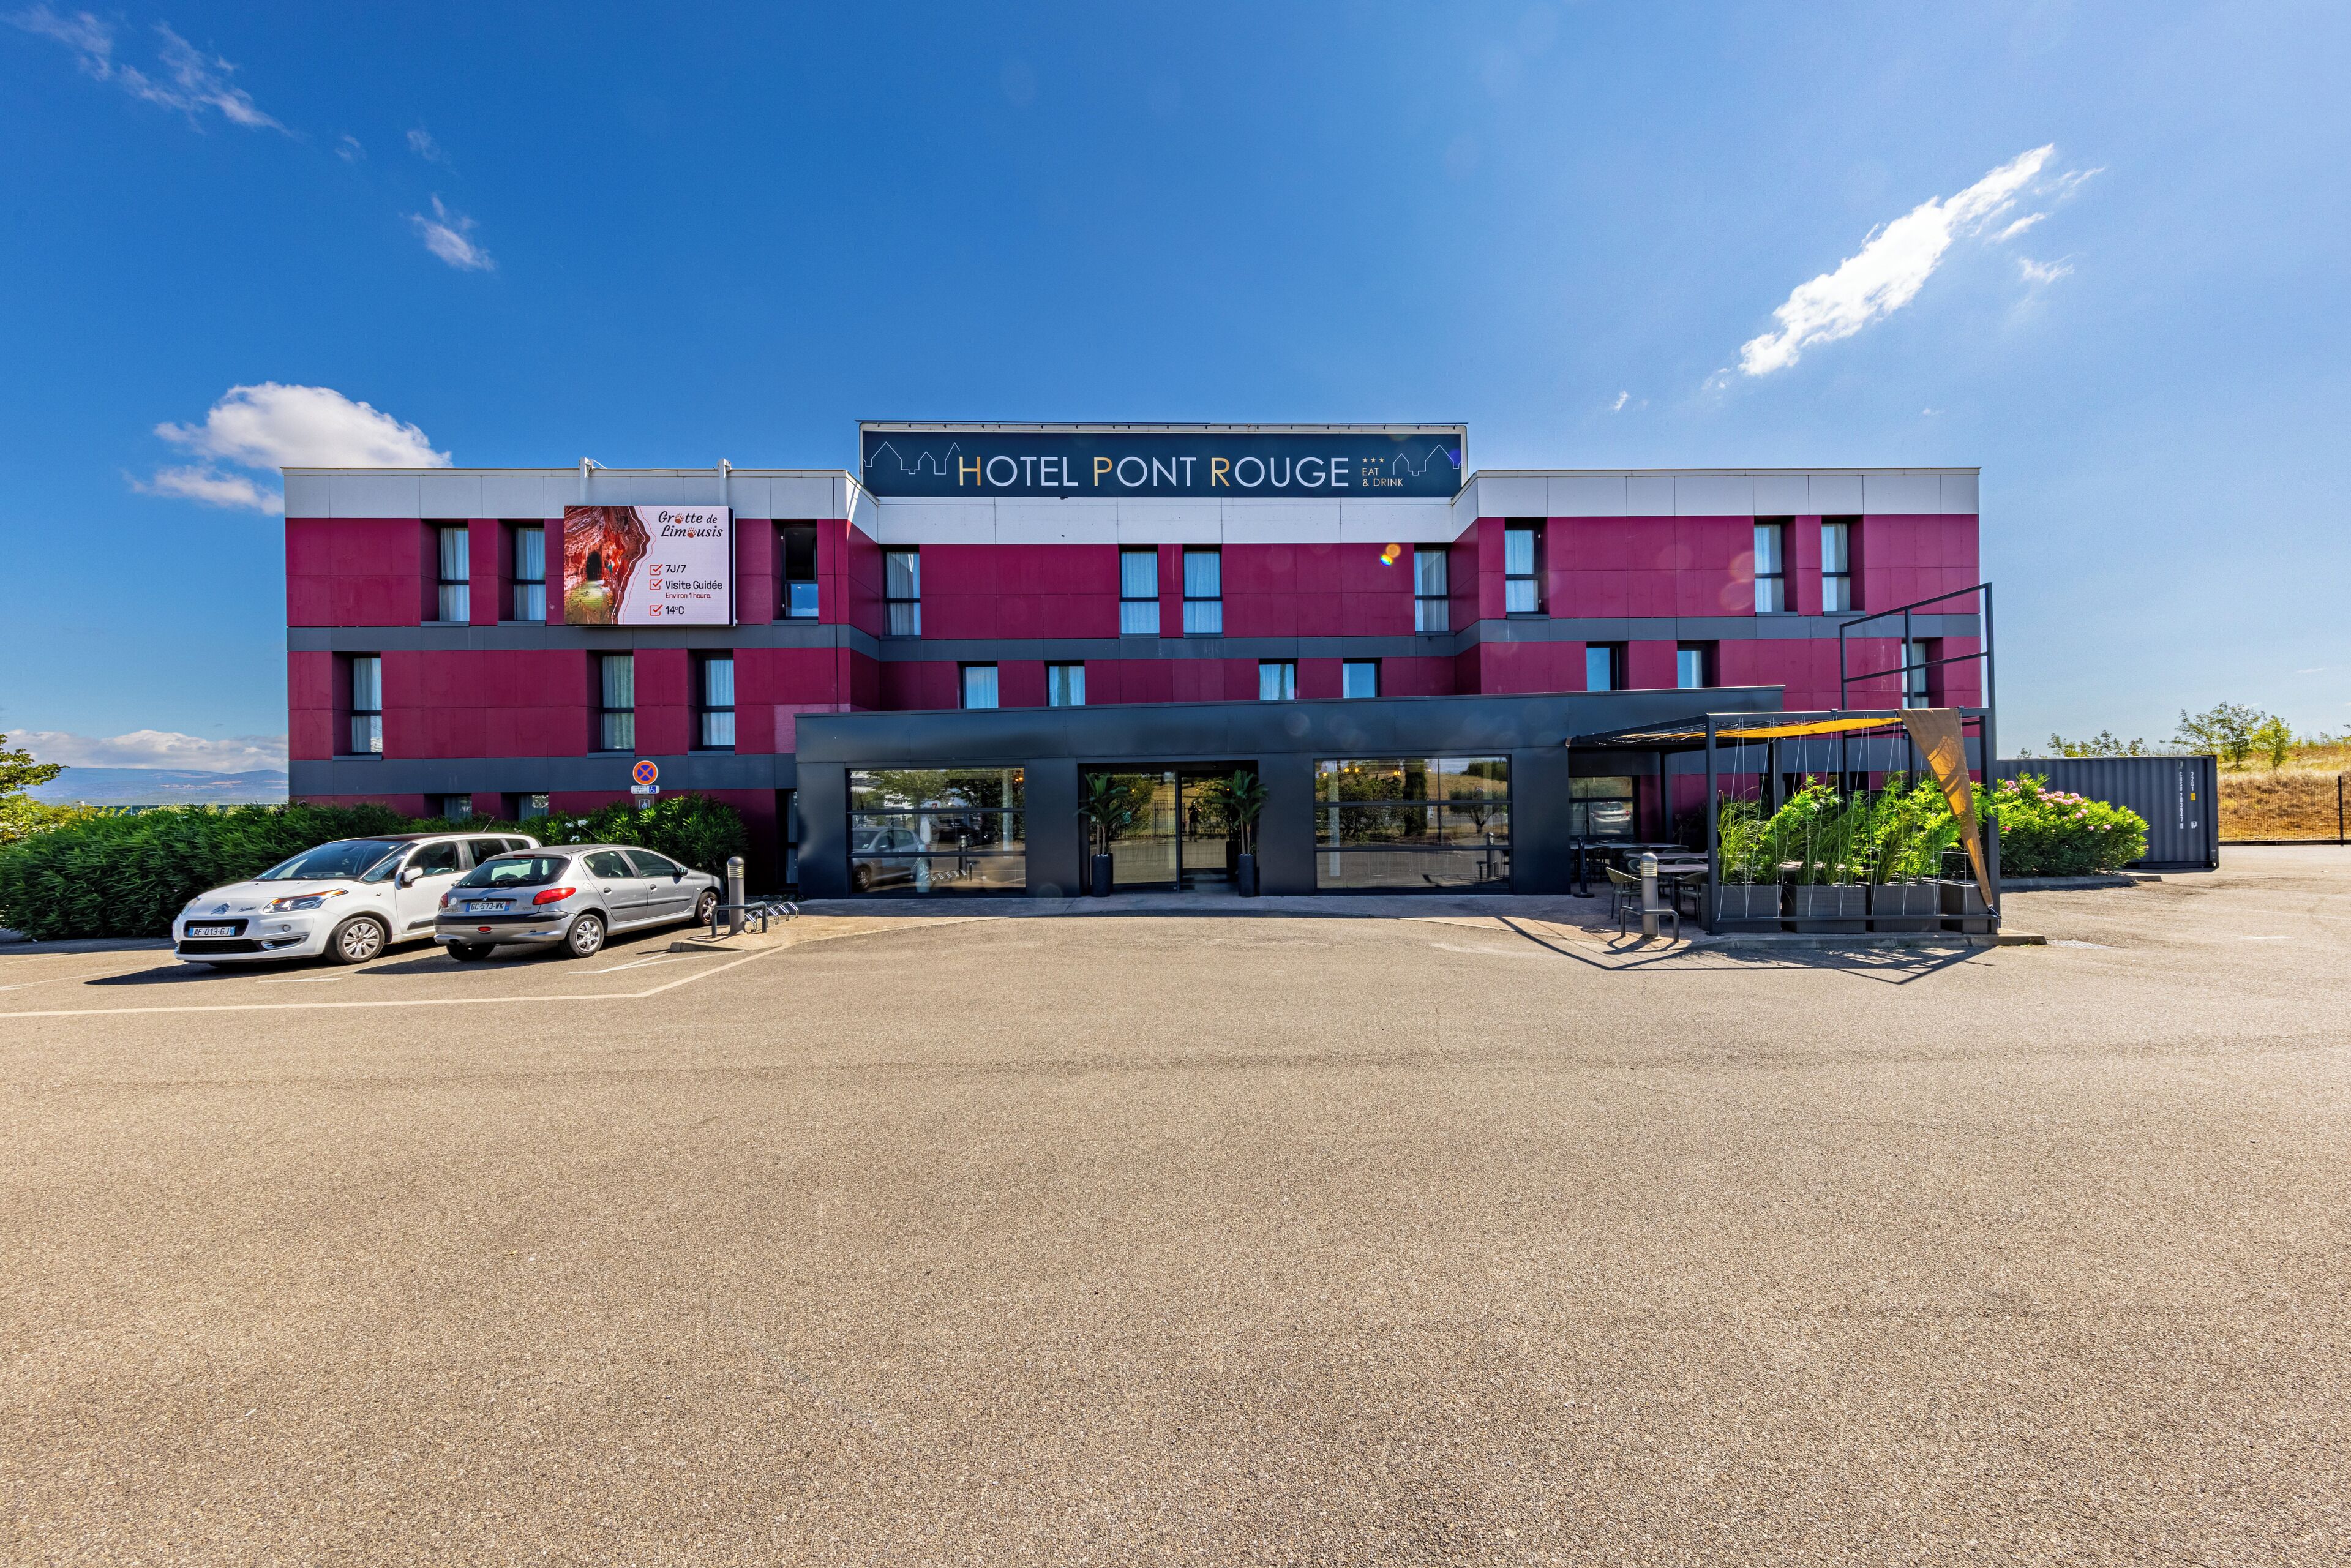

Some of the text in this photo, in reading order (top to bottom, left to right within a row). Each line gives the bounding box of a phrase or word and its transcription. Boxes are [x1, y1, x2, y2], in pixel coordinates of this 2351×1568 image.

[959, 456, 1349, 487] HOTEL PONT ROUGE
[1362, 478, 1403, 487] & DRINK
[706, 514, 718, 523] de
[666, 565, 686, 574] 7J/7
[666, 580, 722, 590] Visite Guidée
[666, 606, 684, 615] 14°C
